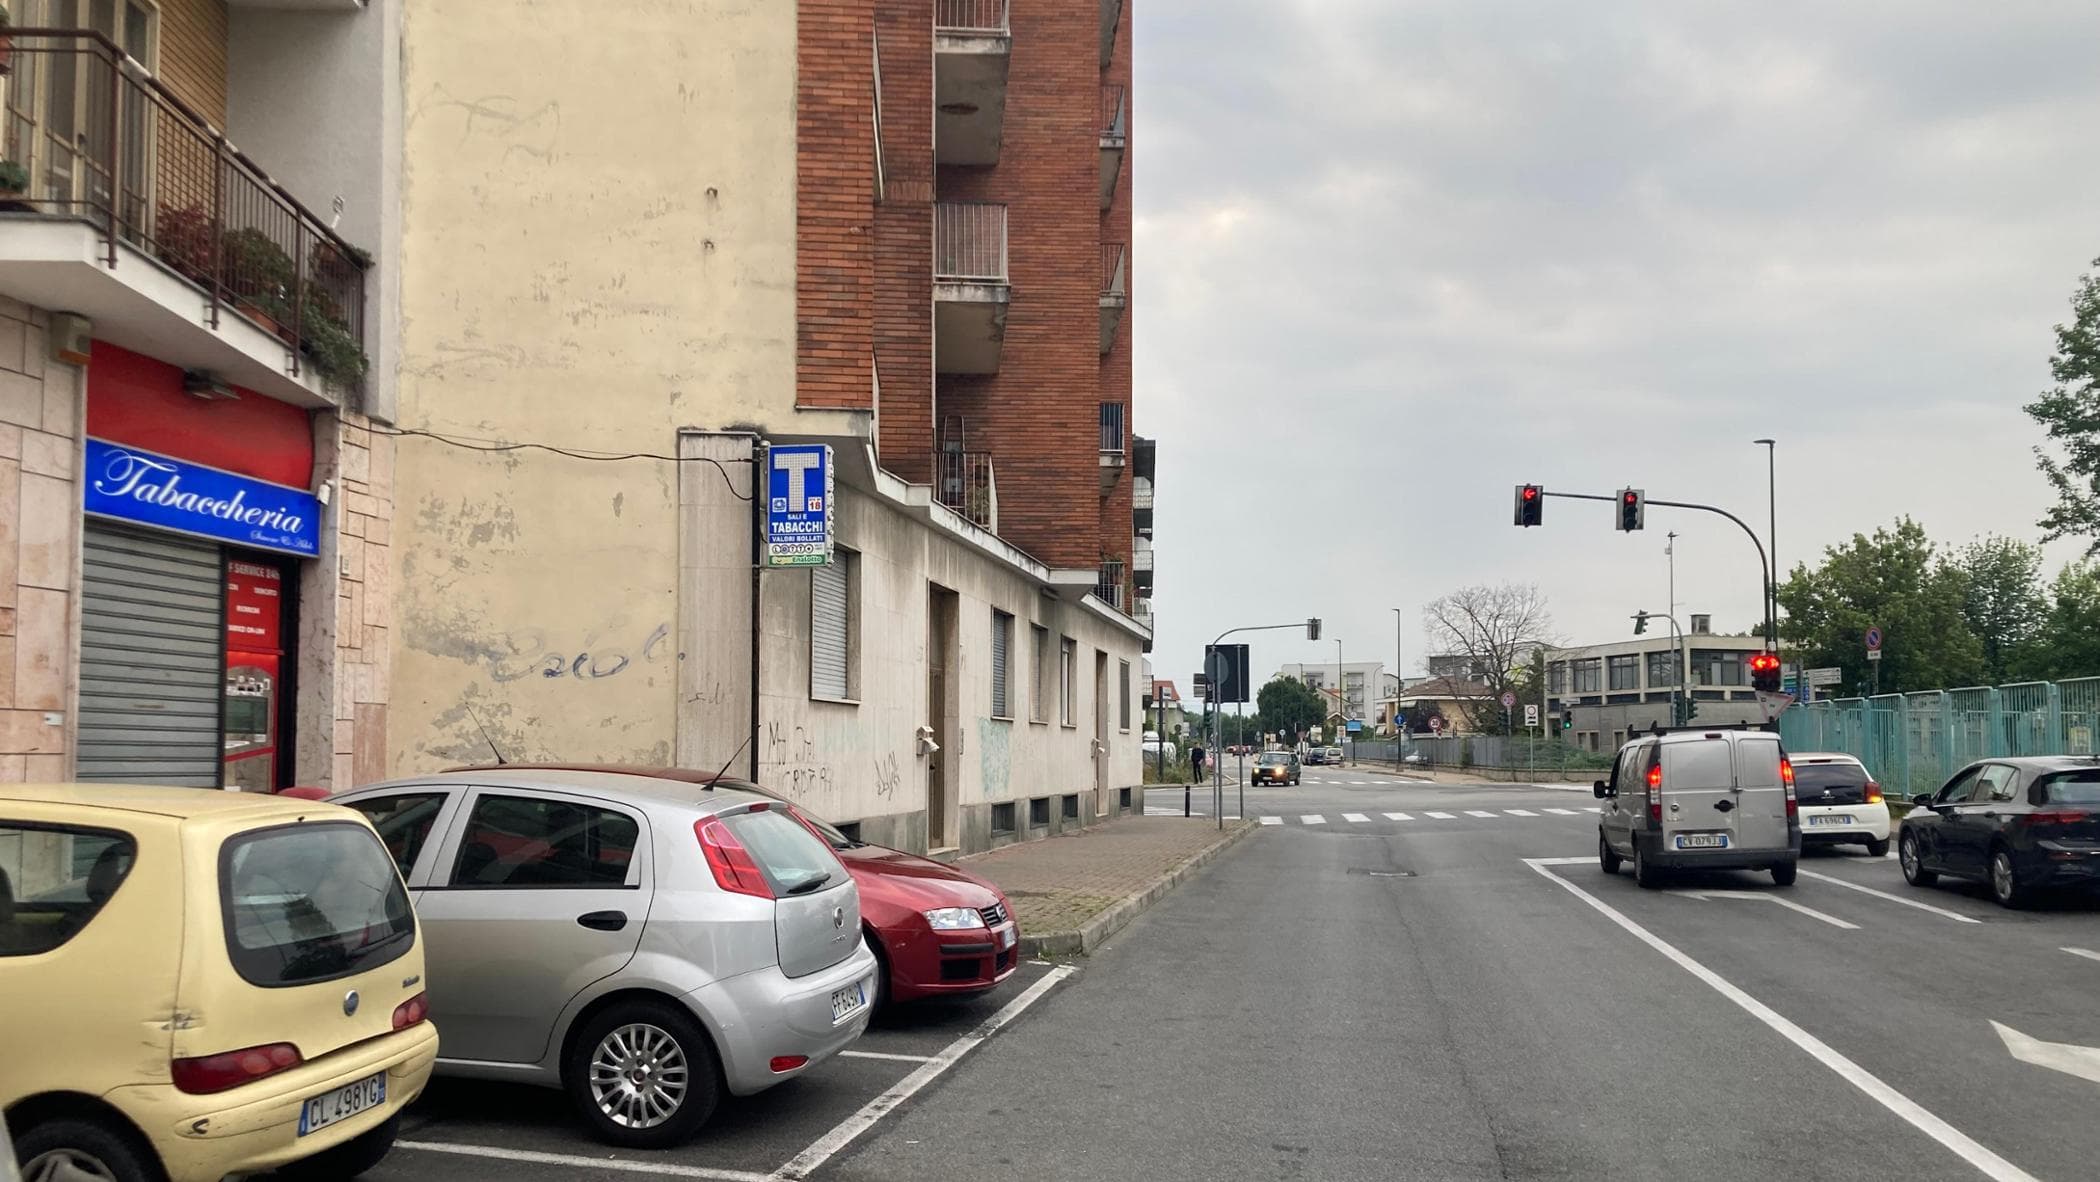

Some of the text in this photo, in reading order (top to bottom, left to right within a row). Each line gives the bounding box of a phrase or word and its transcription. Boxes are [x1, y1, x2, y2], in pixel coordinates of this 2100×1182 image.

[94, 449, 304, 534] Tabaccheria
[774, 453, 820, 512] T
[771, 521, 823, 533] TABACCHI
[234, 563, 265, 577] SERVICE
[310, 1077, 378, 1127] CL 498YG
